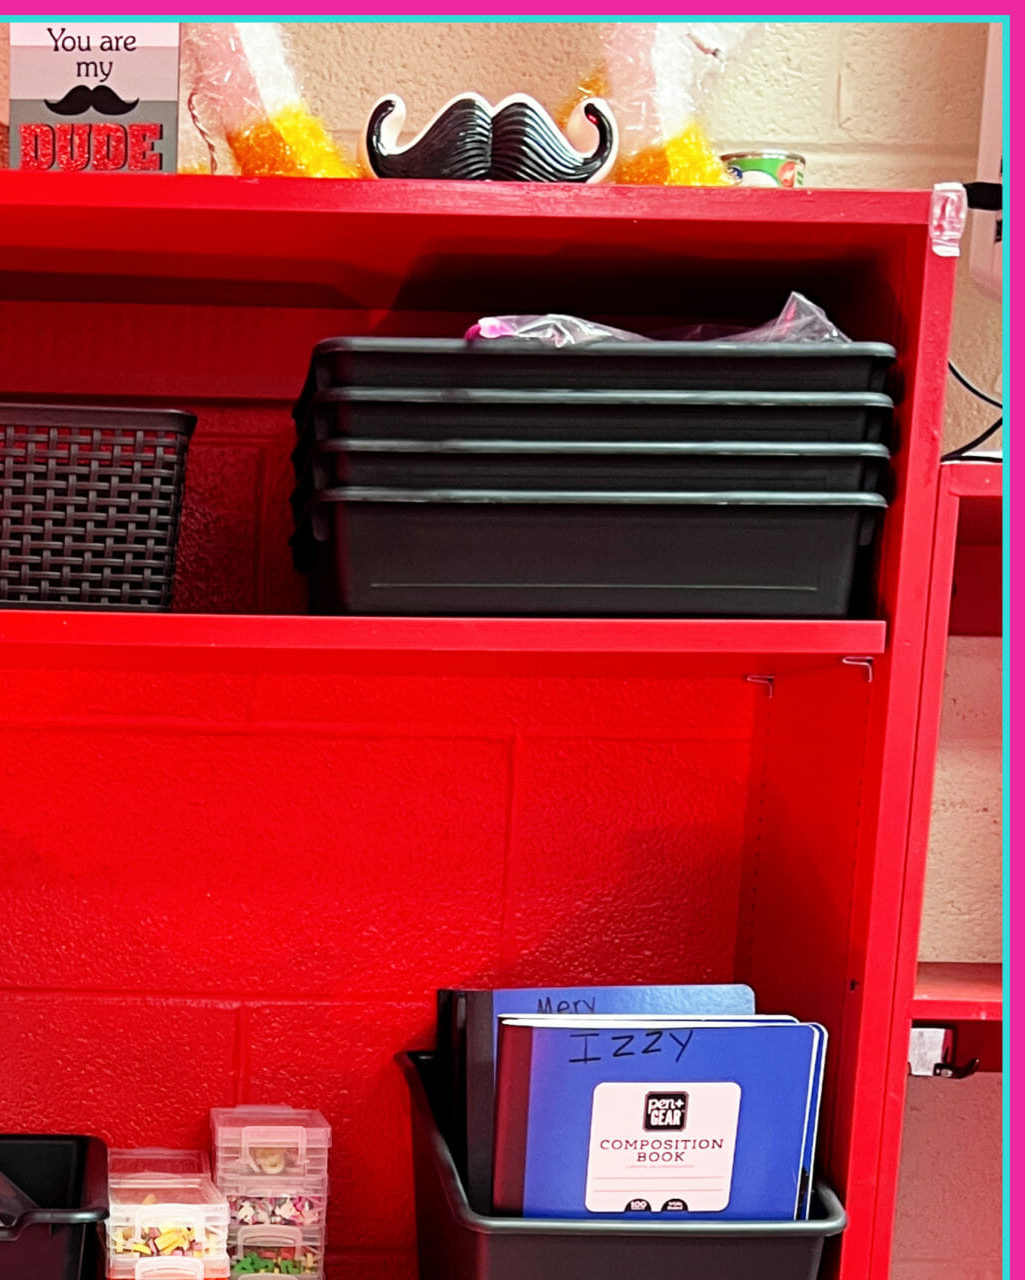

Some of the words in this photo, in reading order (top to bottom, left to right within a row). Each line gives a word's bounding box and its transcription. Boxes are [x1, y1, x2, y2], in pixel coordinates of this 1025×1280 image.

[46, 27, 92, 52] You
[99, 35, 138, 52] are
[75, 61, 114, 83] my
[19, 122, 164, 171] DUDE
[650, 1109, 682, 1126] GEAR
[599, 1138, 725, 1151] COMPOSITION
[636, 1151, 686, 1163] BOOK
